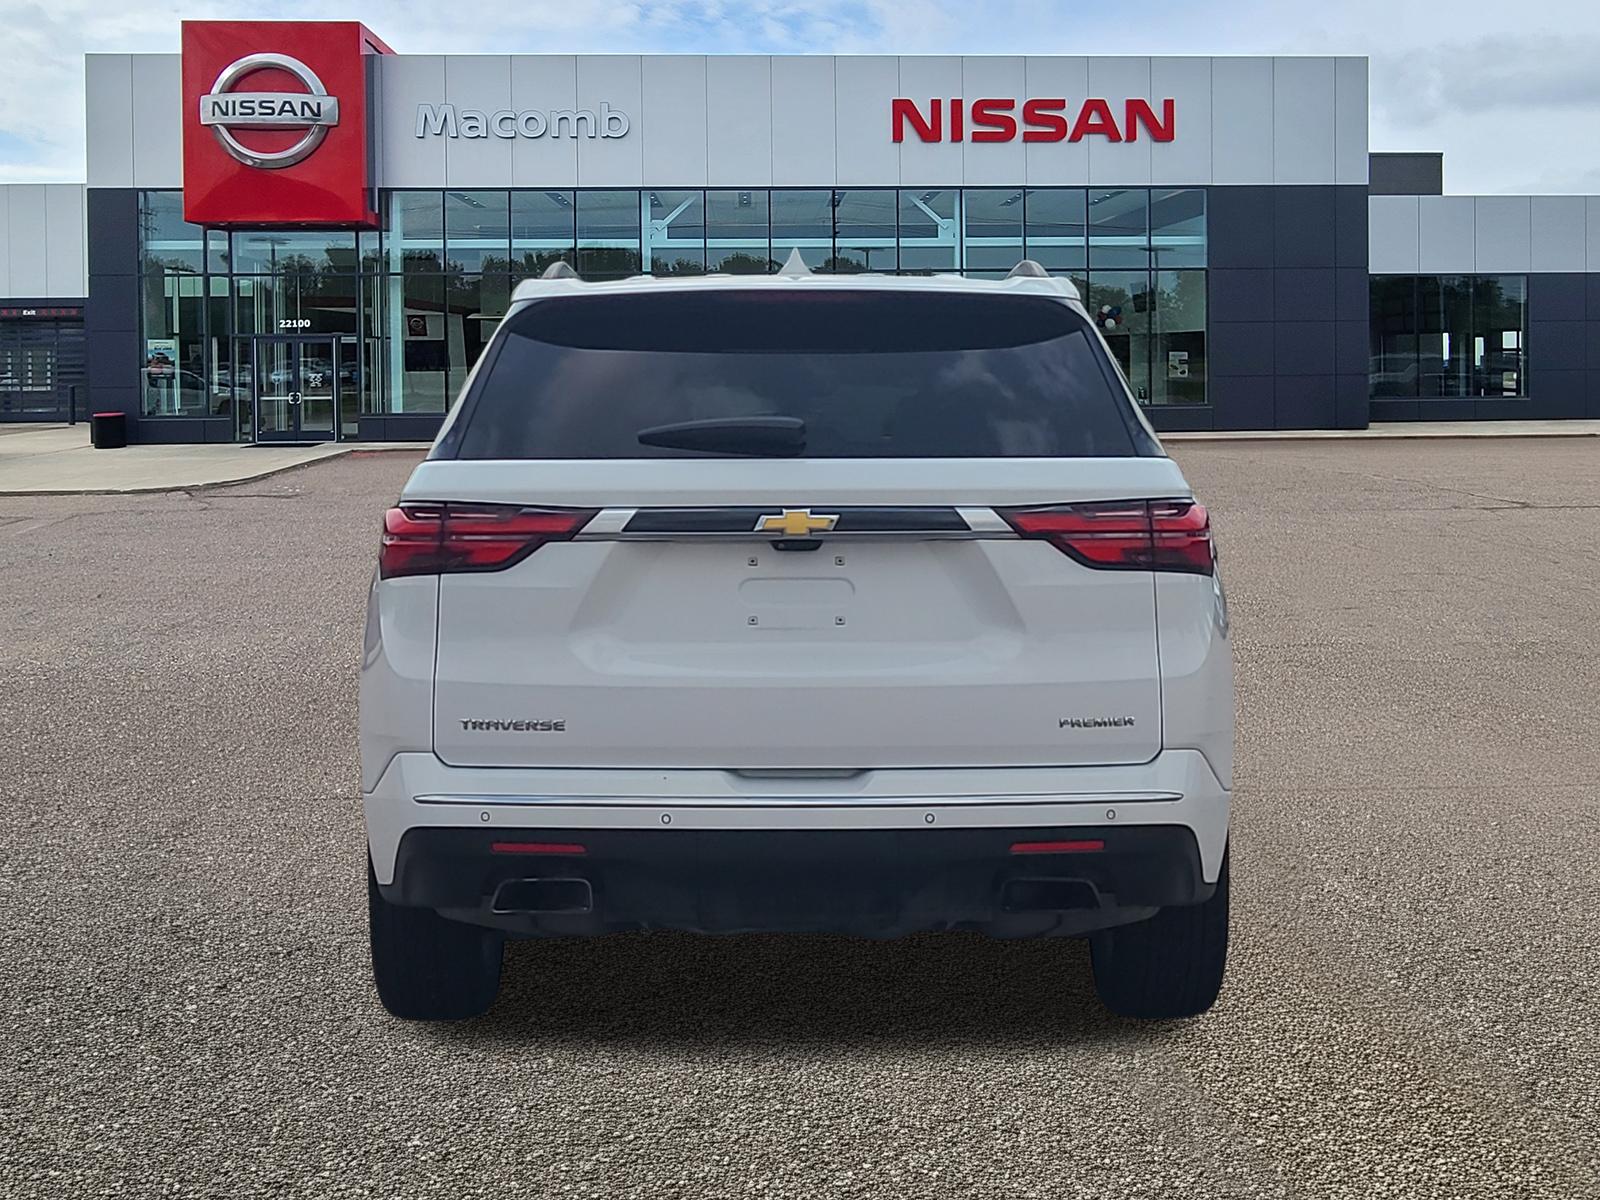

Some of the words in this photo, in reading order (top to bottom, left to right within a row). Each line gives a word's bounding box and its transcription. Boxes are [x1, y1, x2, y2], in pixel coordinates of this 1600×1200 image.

[211, 99, 322, 118] NISSAN
[415, 101, 630, 139] Macomb
[892, 98, 1175, 143] NISSAN
[279, 319, 311, 329] 22100
[460, 718, 566, 732] TRAVERSE
[1059, 715, 1135, 729] PREMIER
